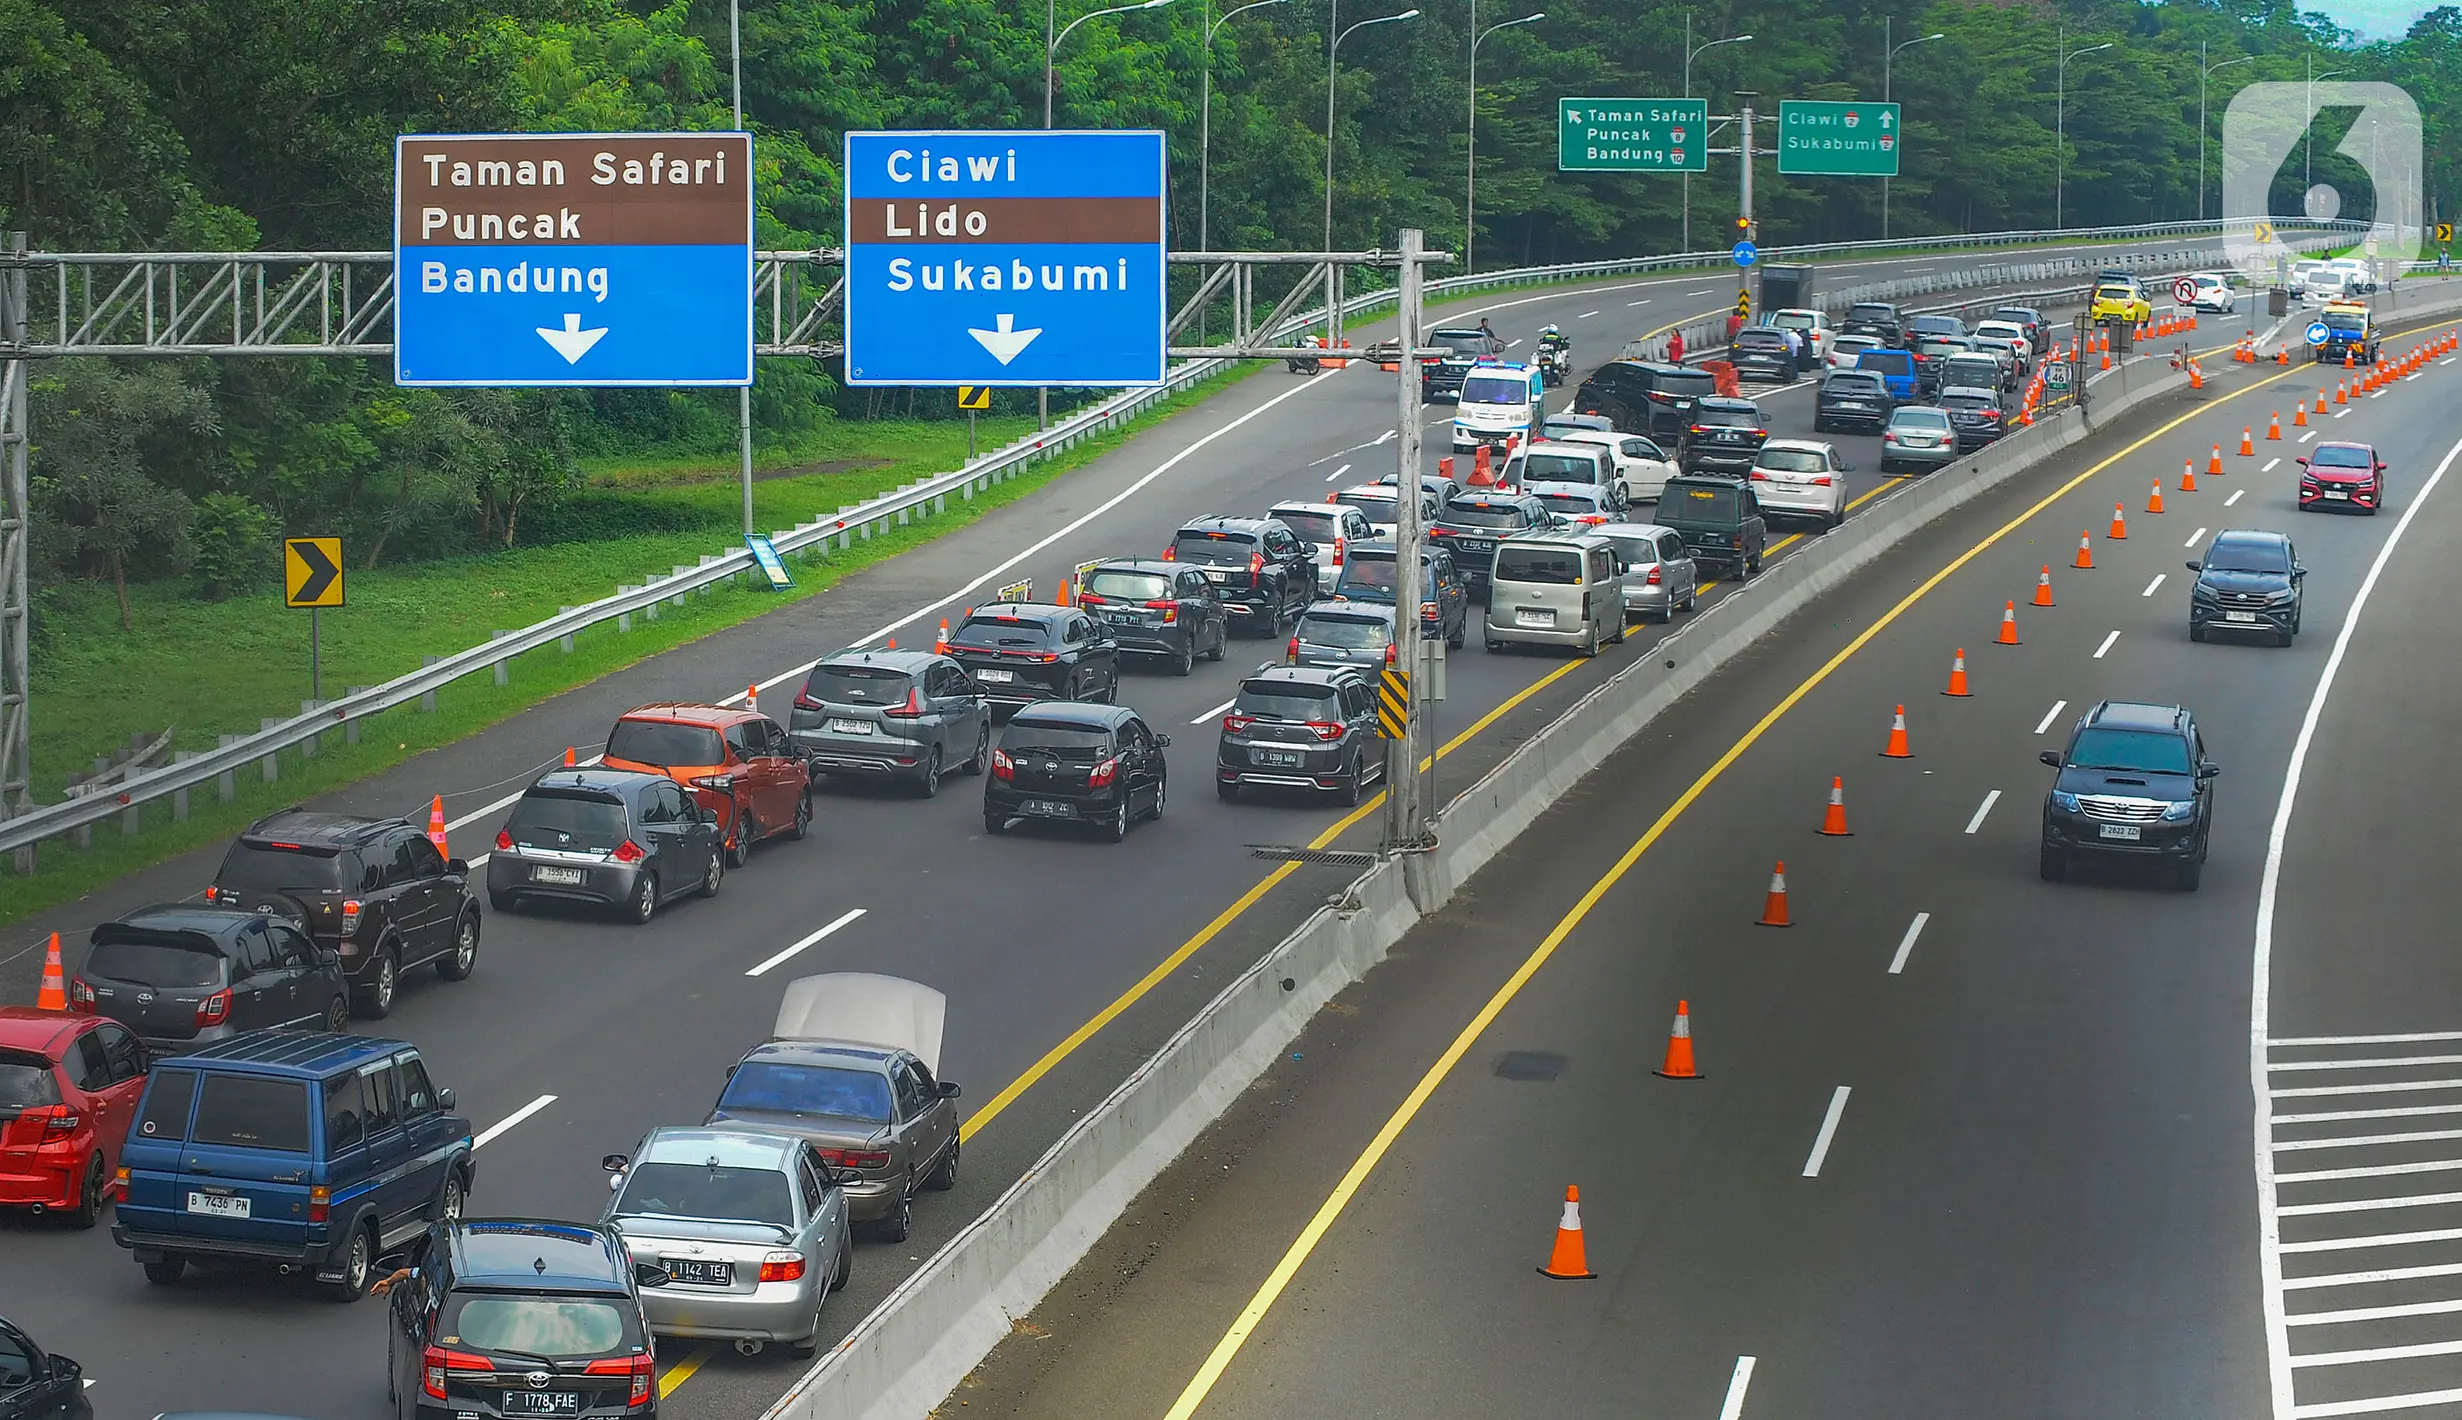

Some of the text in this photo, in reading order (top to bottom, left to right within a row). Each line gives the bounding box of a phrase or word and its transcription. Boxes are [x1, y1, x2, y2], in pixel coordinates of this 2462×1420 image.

[1588, 108, 1701, 122] Taman Safari
[1789, 112, 1837, 125] Ciawi
[1588, 129, 1650, 140] Puncak
[1789, 137, 1876, 151] Sukabumi
[1588, 147, 1682, 163] Bandung 10
[422, 150, 726, 187] Taman Safari
[887, 149, 1017, 182] Ciawi
[422, 207, 582, 240] Puncak
[886, 203, 987, 237] Lido
[422, 261, 608, 303] Bandung
[887, 257, 1128, 292] Sukabumi
[2052, 373, 2064, 382] 46
[2108, 826, 2124, 834] 2822
[205, 1187, 228, 1195] TOYOTA
[191, 1194, 248, 1211] B 7436 PN
[665, 1262, 727, 1277] B 1142 TEA
[506, 1392, 575, 1408] F 1778 FAE
